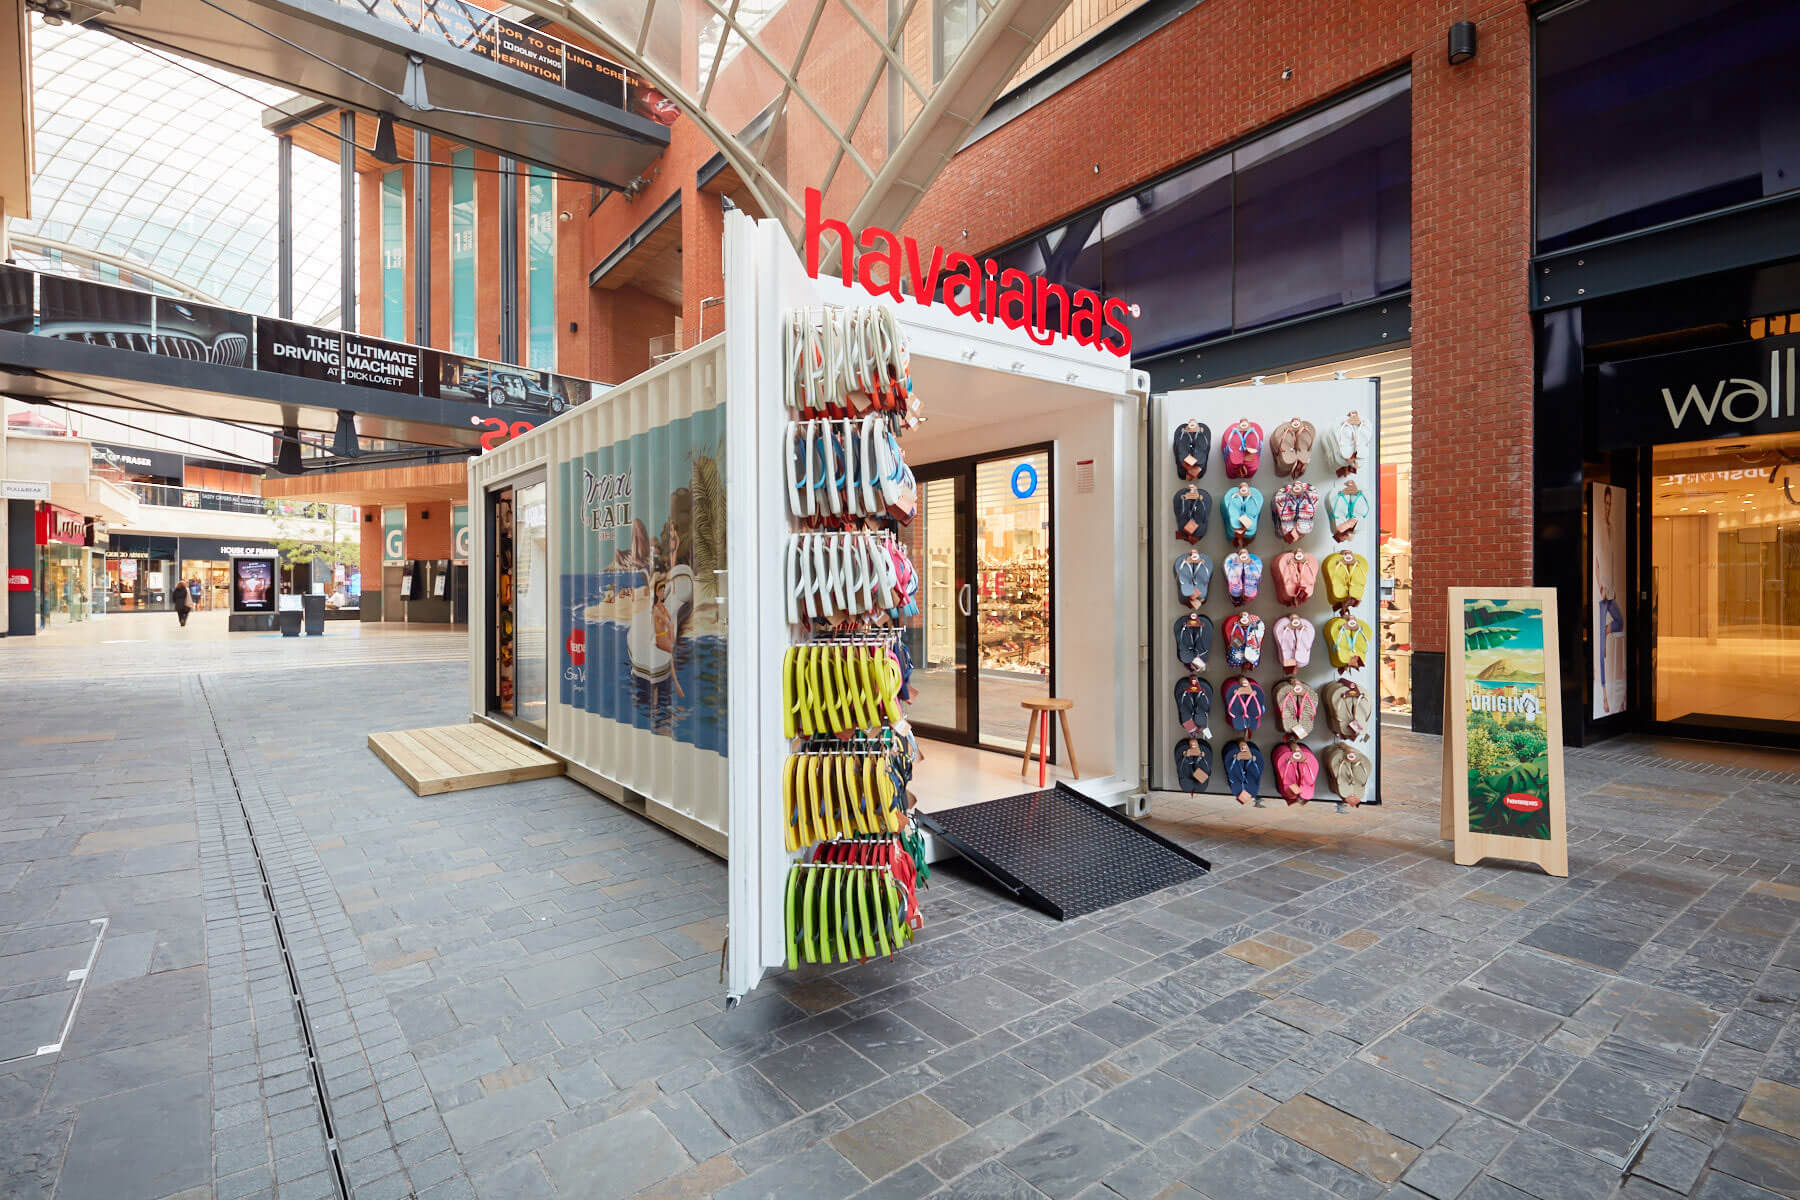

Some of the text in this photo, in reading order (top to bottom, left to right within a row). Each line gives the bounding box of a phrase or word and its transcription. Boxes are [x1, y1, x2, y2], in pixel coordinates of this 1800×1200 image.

[491, 49, 561, 82] DEFINITION
[513, 42, 537, 60] DOLBY
[538, 55, 562, 69] ATMOS
[527, 36, 544, 49] TO
[546, 44, 593, 69] CELING
[595, 63, 639, 87] SCREEN
[804, 186, 1134, 358] havaianas
[273, 343, 415, 379] DRIVING MACHINE
[306, 334, 417, 366] THE ULTIMATE
[327, 367, 403, 387] AT DICK LOVETT
[1661, 347, 1796, 429] wall
[220, 546, 244, 555] HOUSE
[244, 547, 255, 555] OF
[386, 529, 403, 558] G
